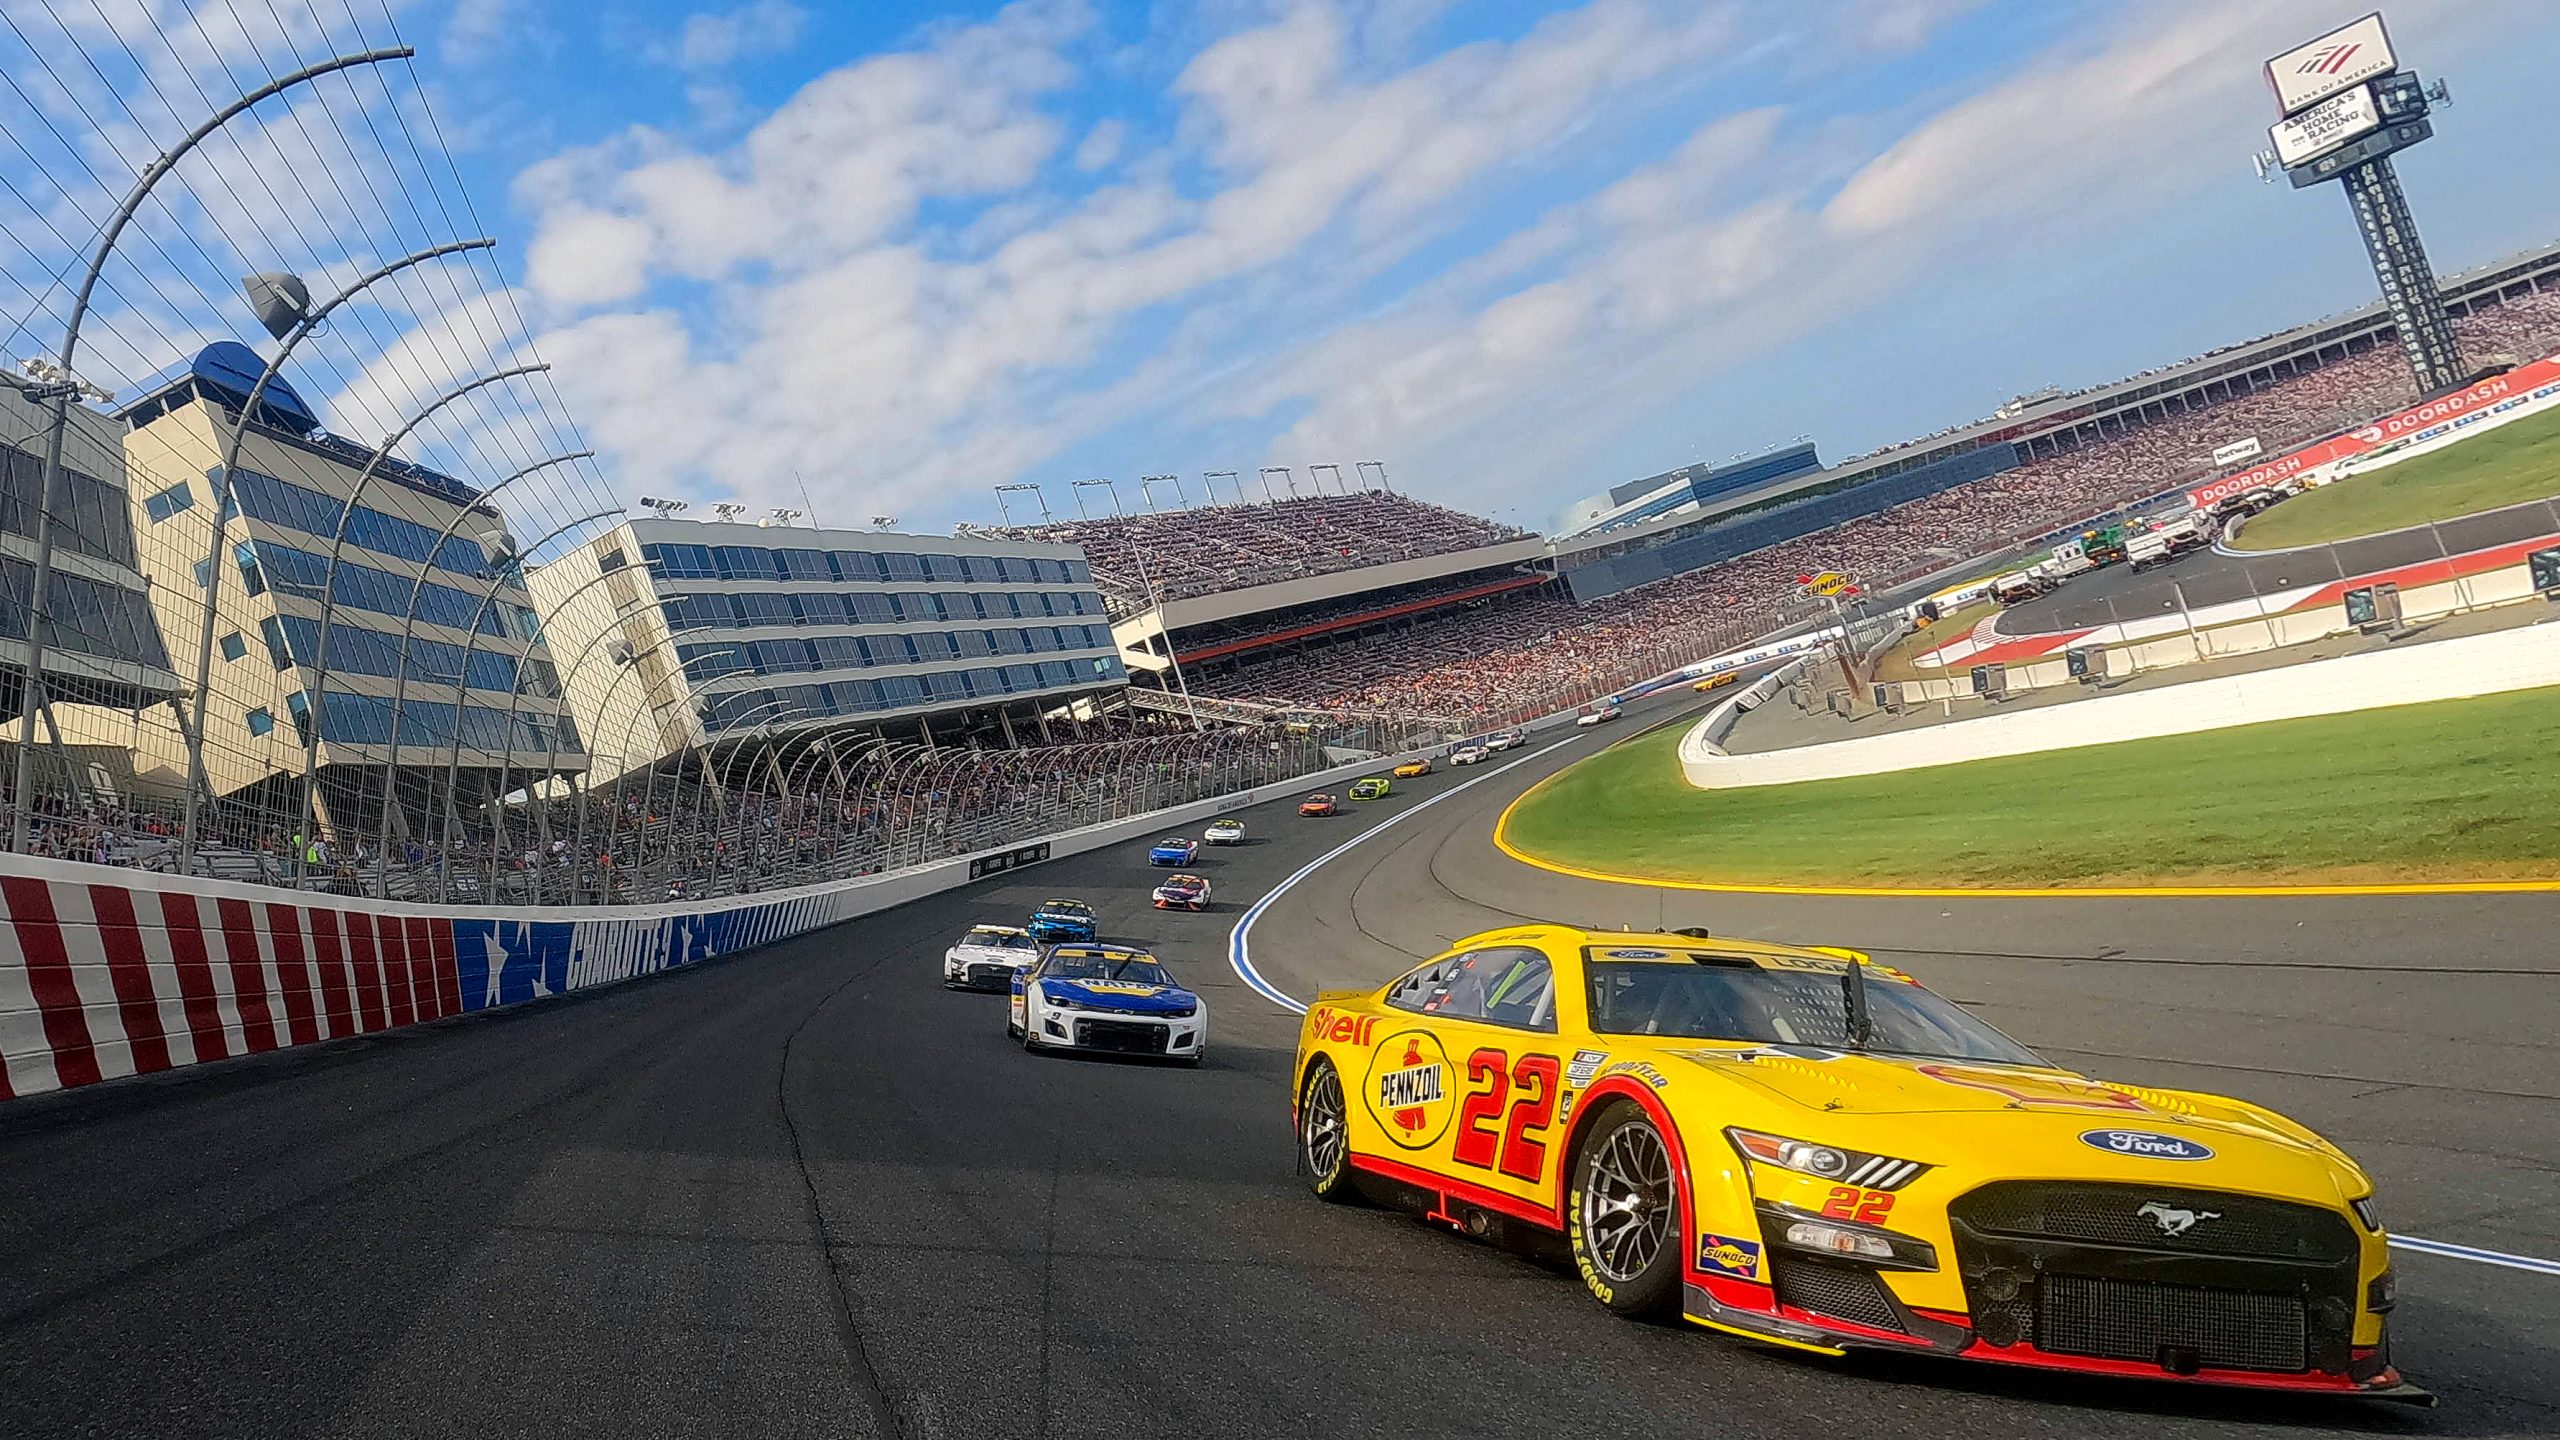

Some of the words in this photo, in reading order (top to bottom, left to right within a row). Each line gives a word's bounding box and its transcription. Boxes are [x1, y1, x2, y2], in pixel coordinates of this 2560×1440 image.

[2289, 90, 2319, 106] BANK
[2321, 82, 2333, 92] OF
[2337, 60, 2387, 85] AMERICA
[2284, 91, 2356, 132] AMERICA'S
[2302, 108, 2343, 132] HOME
[2307, 110, 2359, 140] RACING
[2388, 379, 2509, 433] DOORDASH
[2201, 457, 2301, 501] DOORDASH
[1803, 572, 1854, 598] SUNOCO
[1313, 1007, 1382, 1047] Shell
[1380, 1064, 1442, 1108] PENNZOIL
[1452, 1046, 1561, 1185] 22
[2108, 1130, 2190, 1158] Ford
[1820, 1186, 1896, 1226] 22
[1705, 1248, 1755, 1265] SUNOCO
